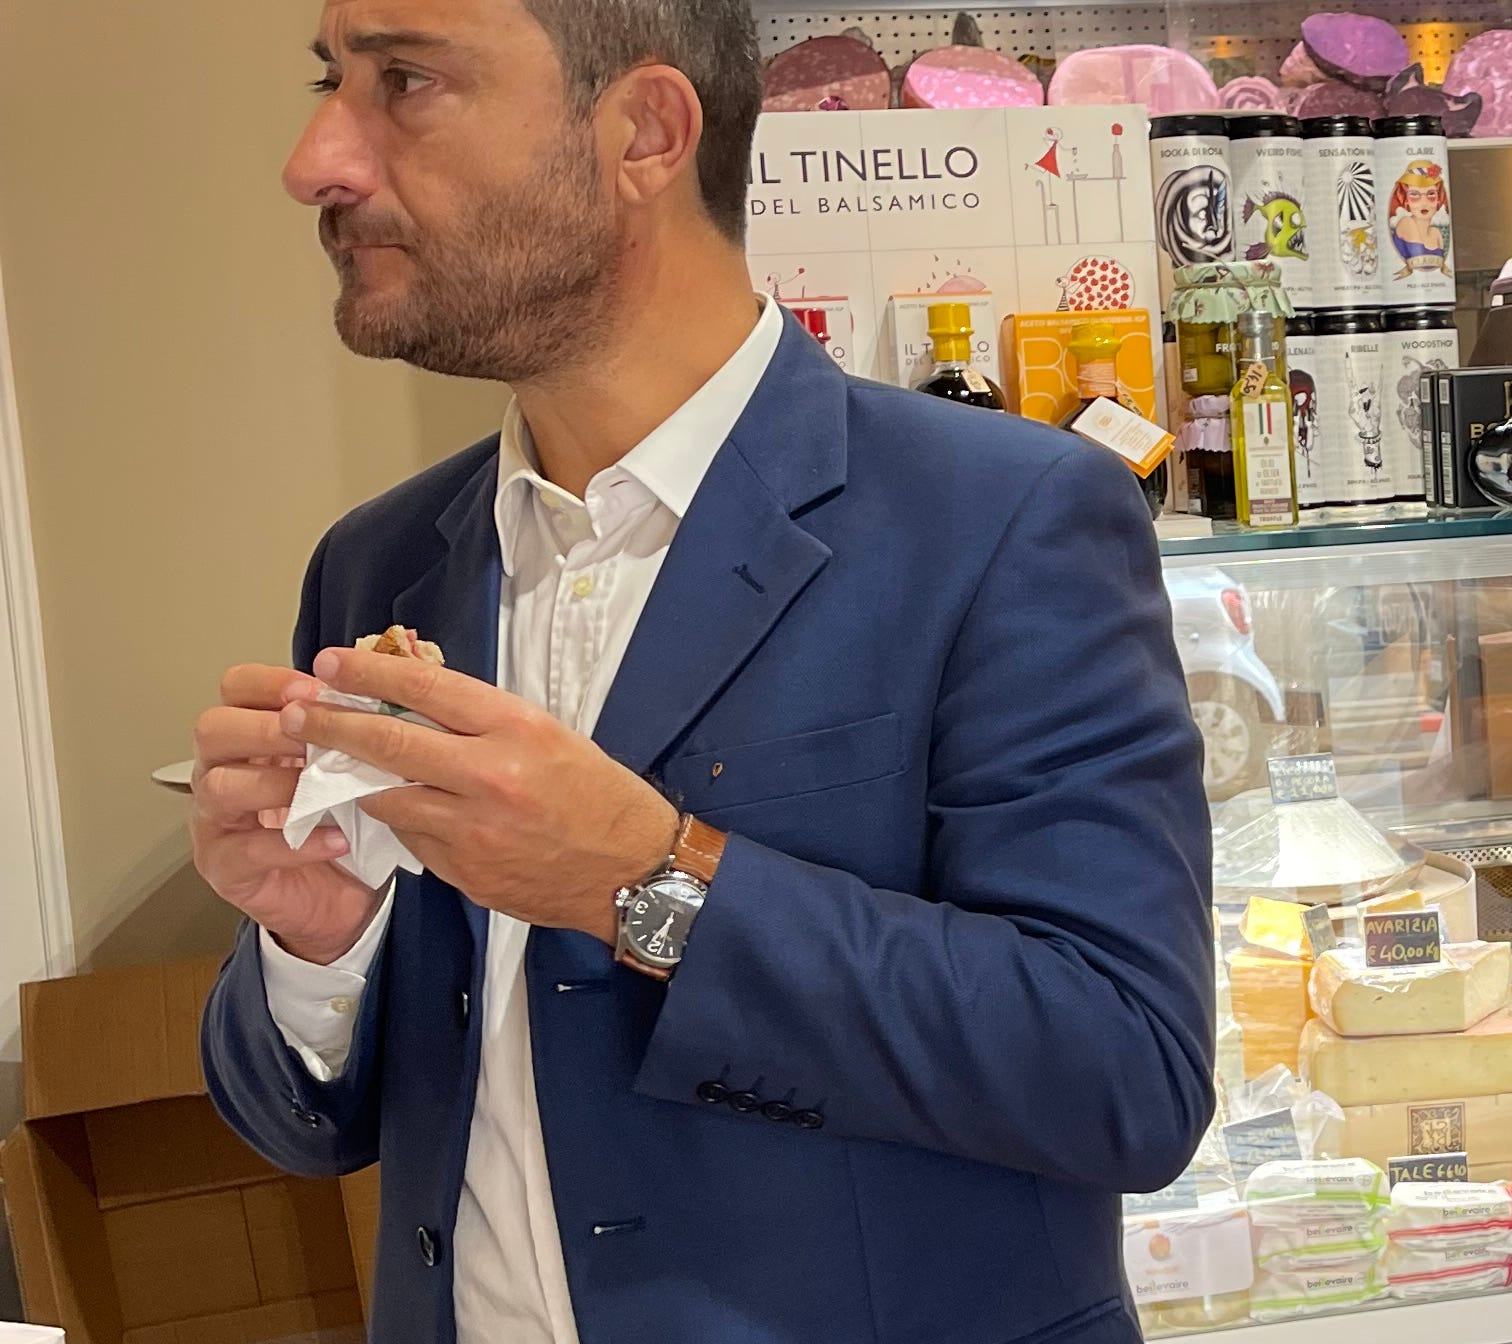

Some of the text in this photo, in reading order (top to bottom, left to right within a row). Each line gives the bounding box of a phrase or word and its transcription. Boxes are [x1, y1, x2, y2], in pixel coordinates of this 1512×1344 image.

[790, 146, 979, 183] TINELLO
[751, 192, 980, 215] DEL BALSAMICO
